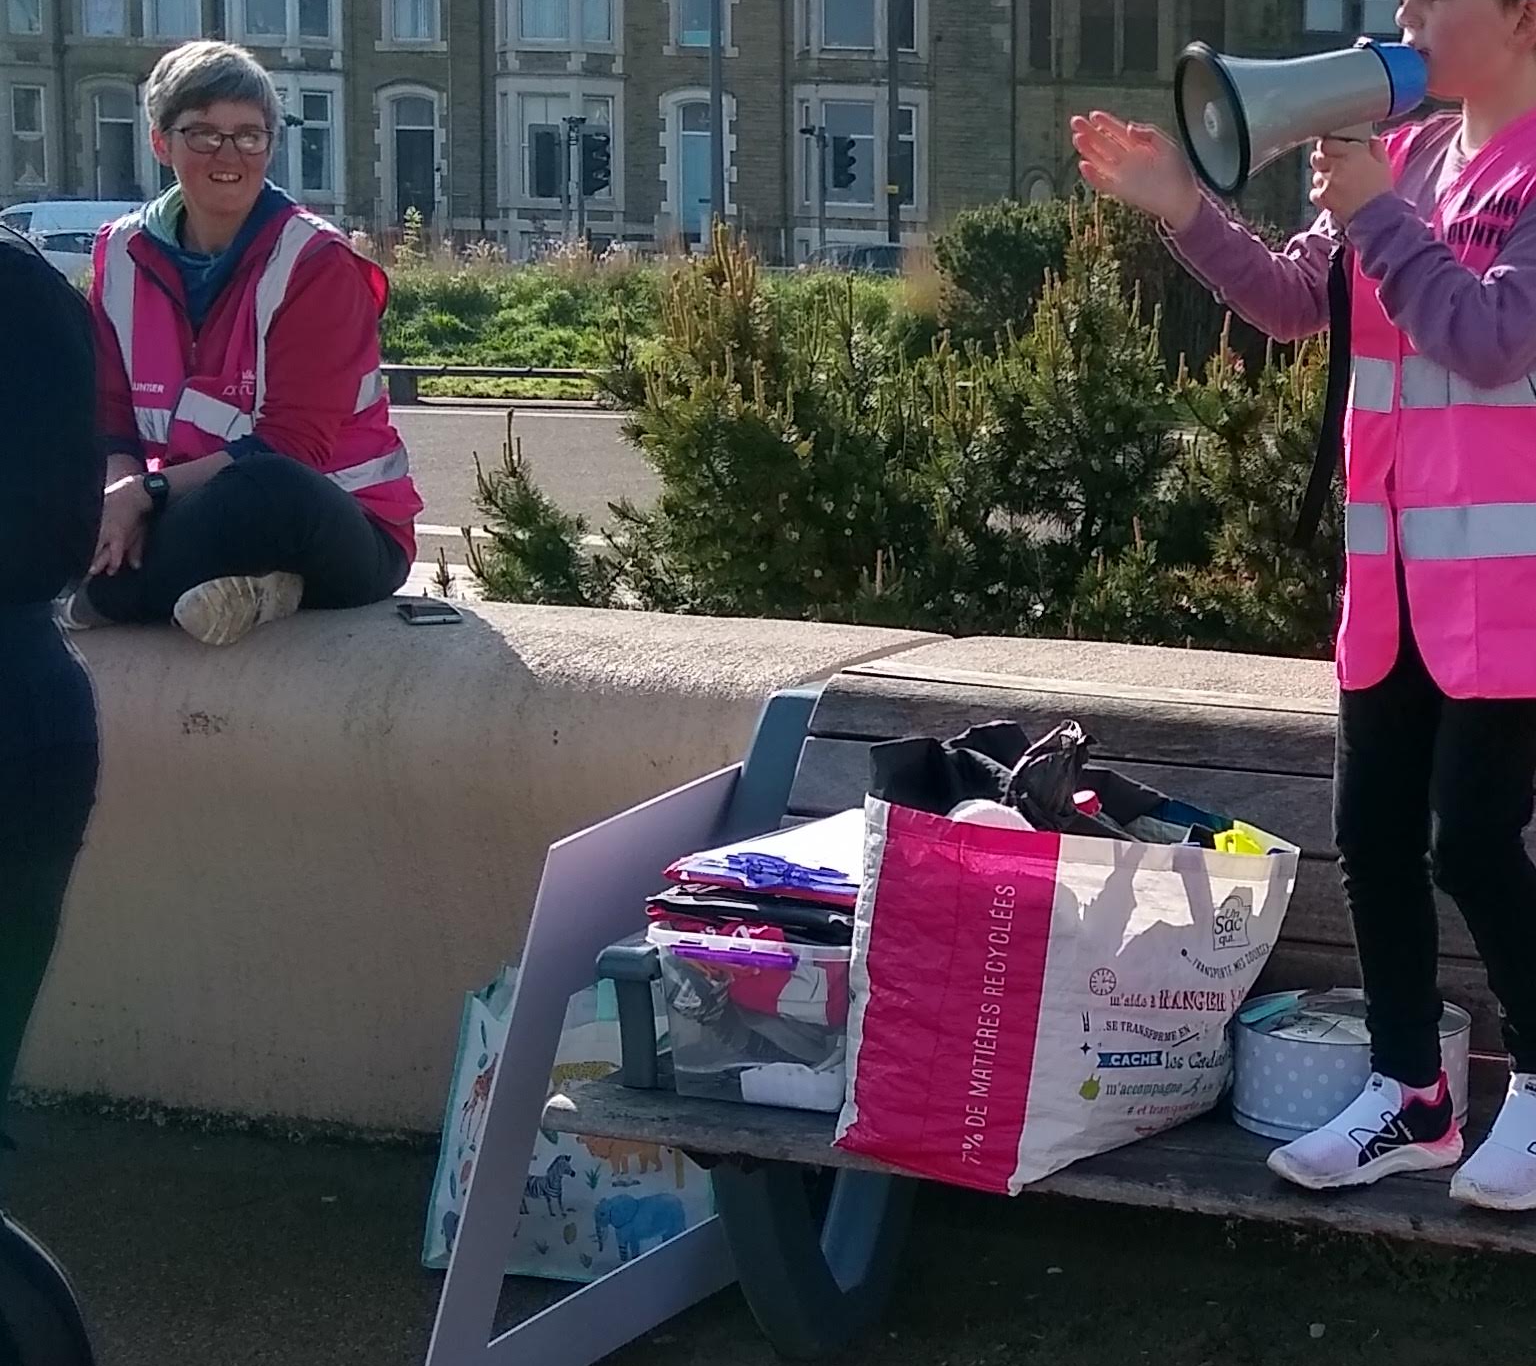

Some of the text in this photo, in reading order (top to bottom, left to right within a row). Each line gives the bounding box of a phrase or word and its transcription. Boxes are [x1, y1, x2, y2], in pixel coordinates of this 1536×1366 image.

[1214, 915, 1243, 935] Sac
[982, 884, 1016, 997] RECYCLÉES
[1159, 989, 1226, 1012] RANGER
[1121, 1021, 1177, 1042] TRANSFORME
[1178, 1023, 1191, 1040] EN
[968, 1003, 1001, 1098] MATIÈRES
[965, 1104, 988, 1127] DE
